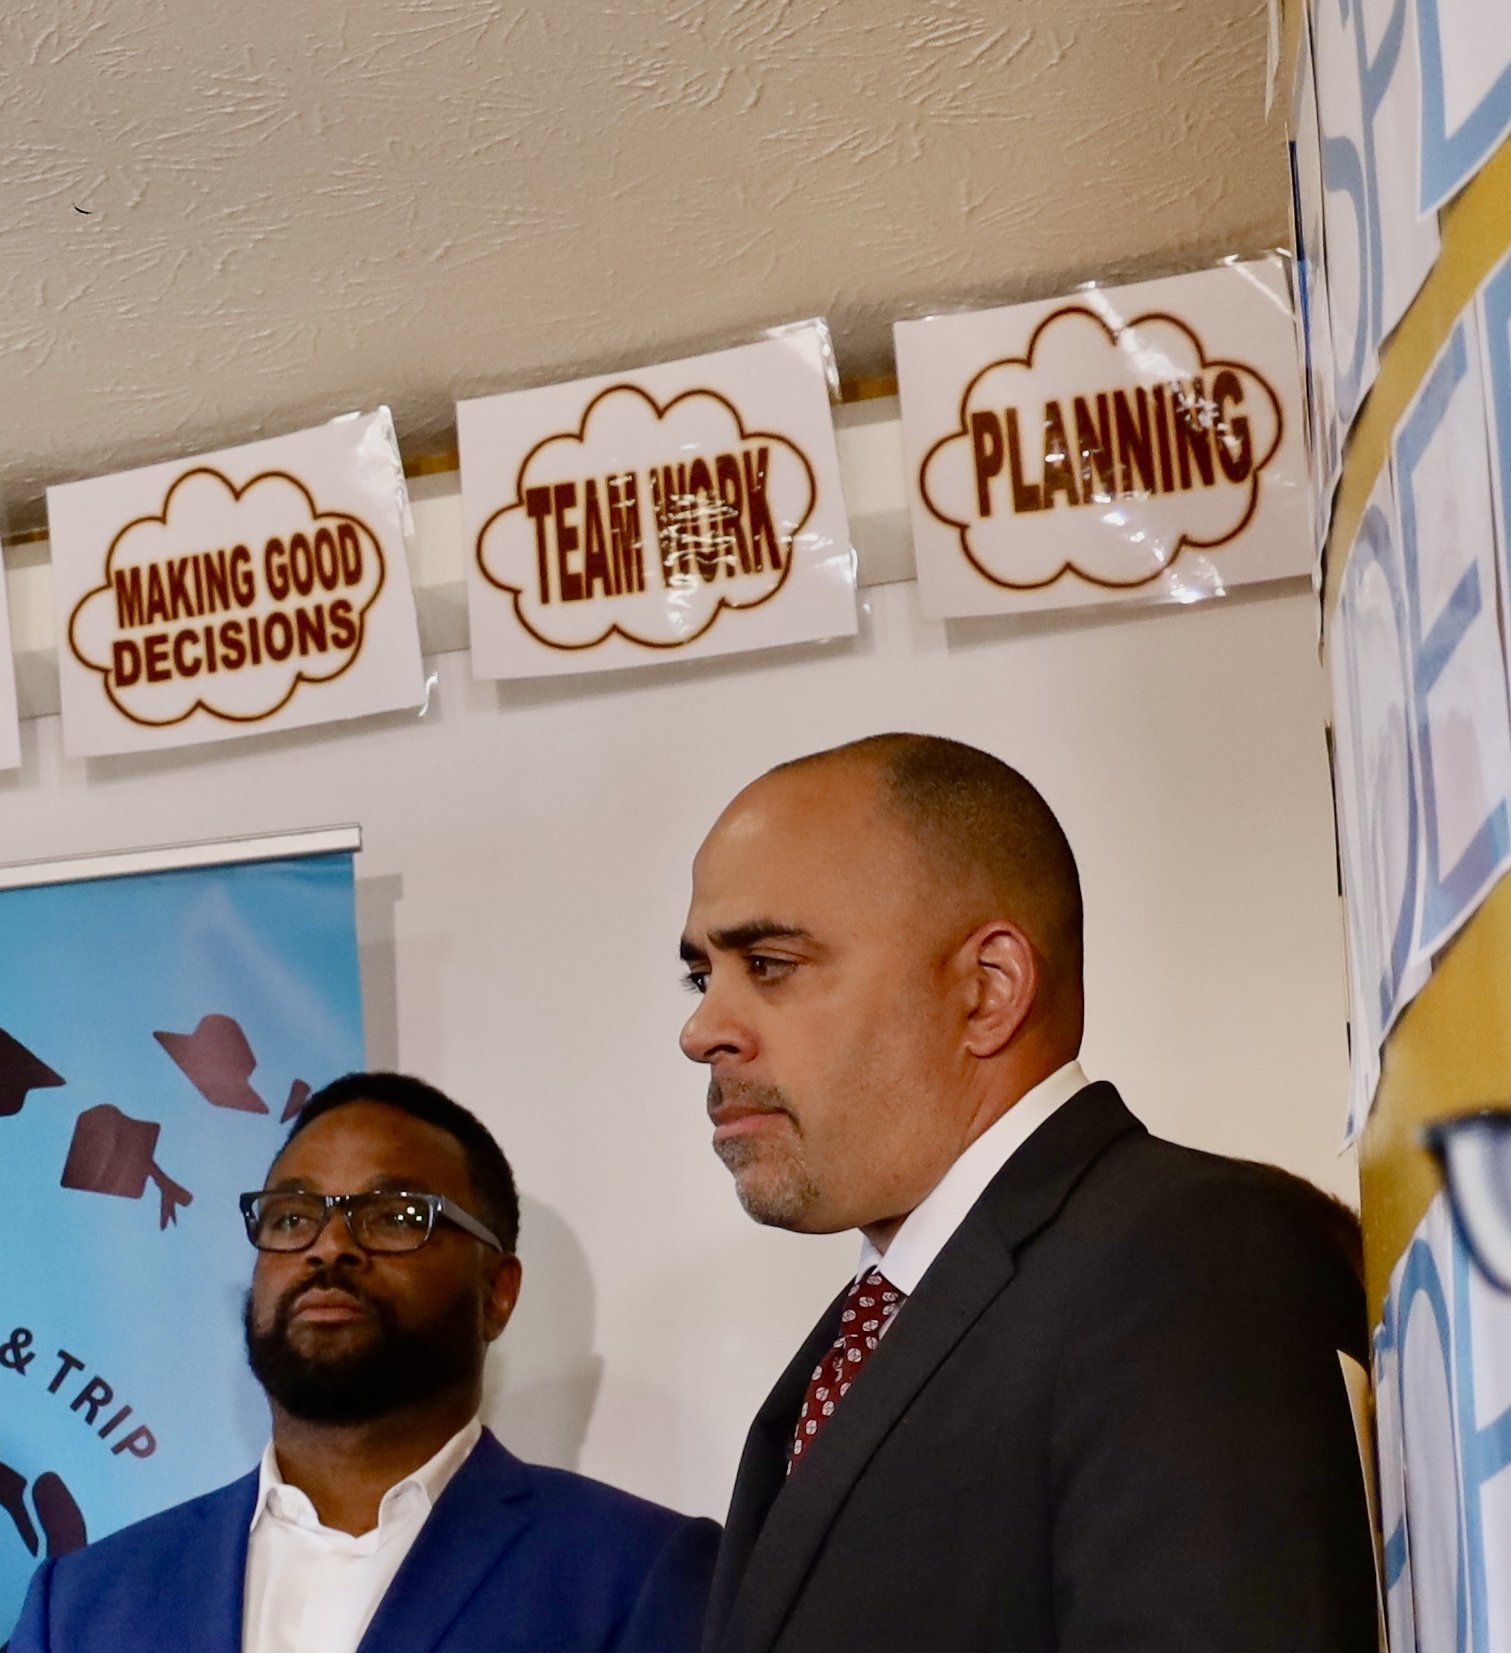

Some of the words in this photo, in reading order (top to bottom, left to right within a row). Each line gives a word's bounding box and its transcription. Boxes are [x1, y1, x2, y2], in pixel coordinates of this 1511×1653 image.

[972, 368, 1255, 519] PLANNING
[116, 544, 254, 628] MAKING
[264, 523, 364, 599] GOOD
[526, 470, 646, 604] TEAM
[651, 447, 781, 588] WORK
[113, 598, 356, 688] DECISIONS
[47, 1349, 157, 1459] TRIP
